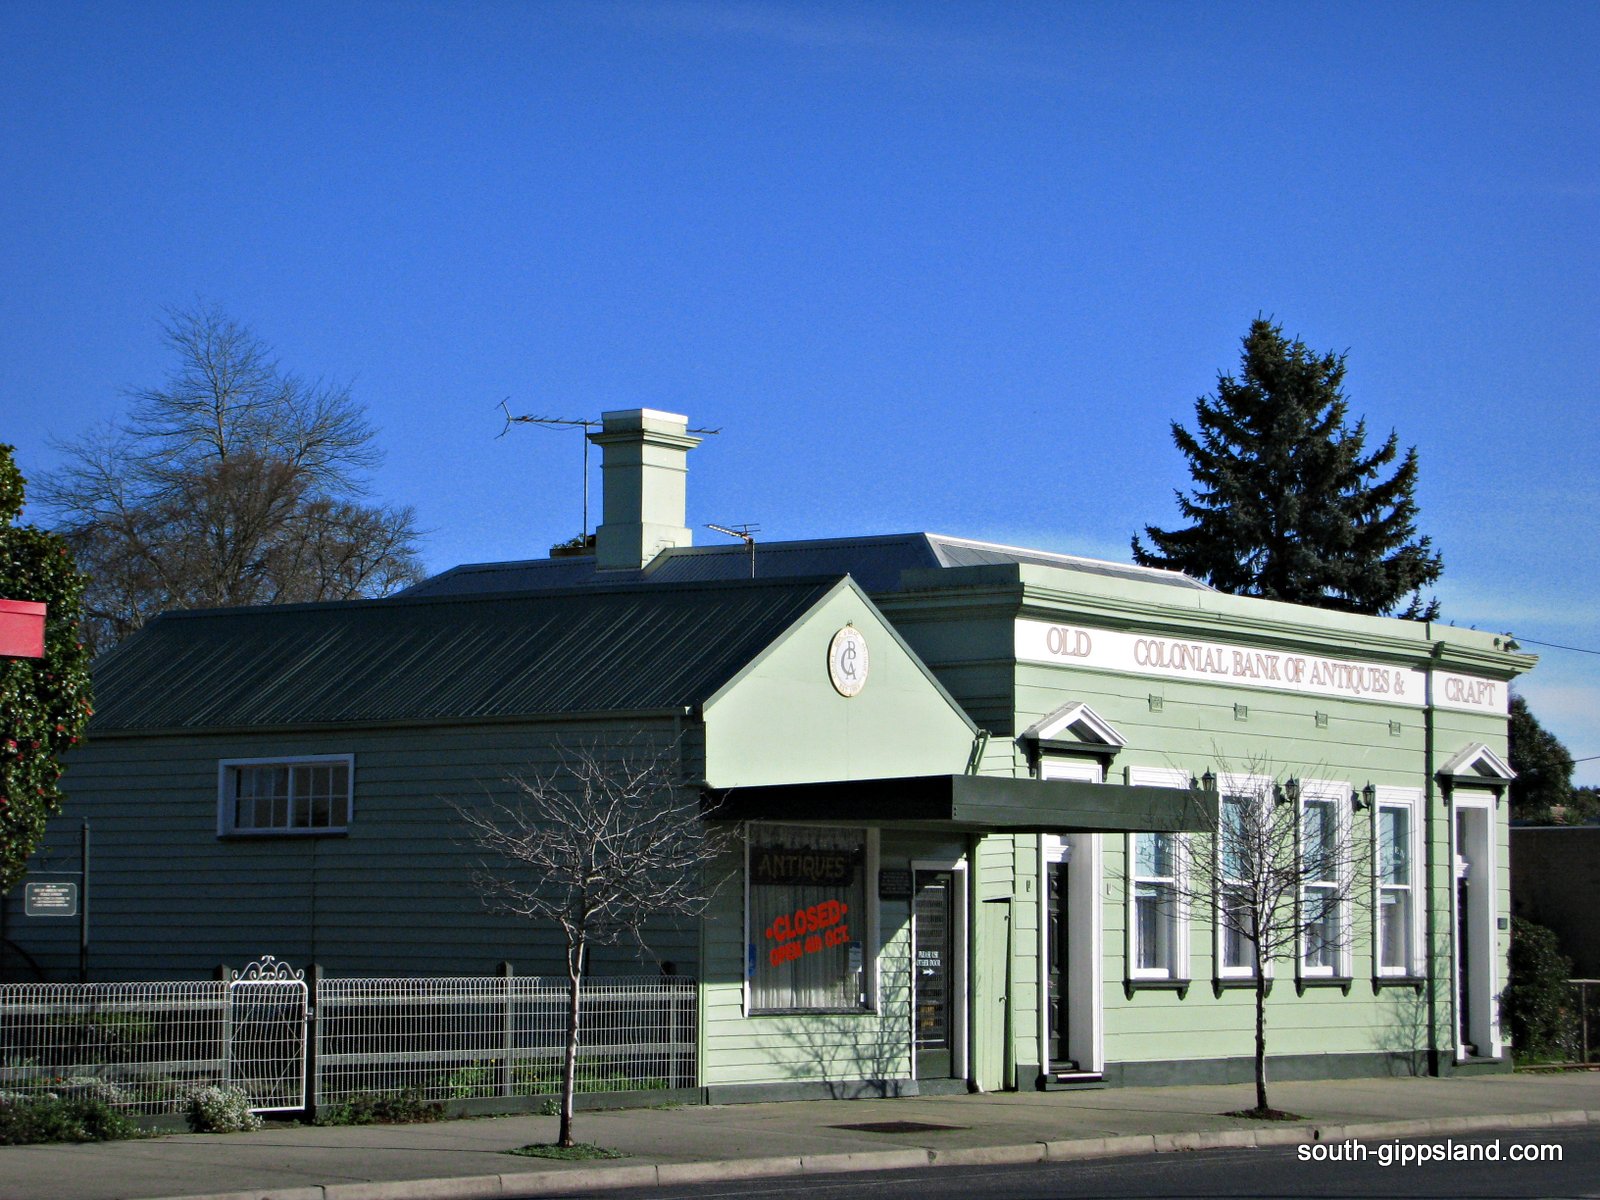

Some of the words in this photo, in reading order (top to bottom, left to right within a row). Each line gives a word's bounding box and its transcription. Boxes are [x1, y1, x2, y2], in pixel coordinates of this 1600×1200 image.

[1046, 626, 1092, 658] OLD
[1133, 638, 1228, 674] COLONIAL
[1232, 650, 1281, 680] BANK
[1284, 656, 1306, 683] OF
[1310, 661, 1390, 695] ANTIQUES
[1394, 670, 1406, 696] &
[1444, 677, 1496, 707] CRAFT
[760, 854, 845, 880] ANTIQUES
[769, 941, 803, 967] OPEN
